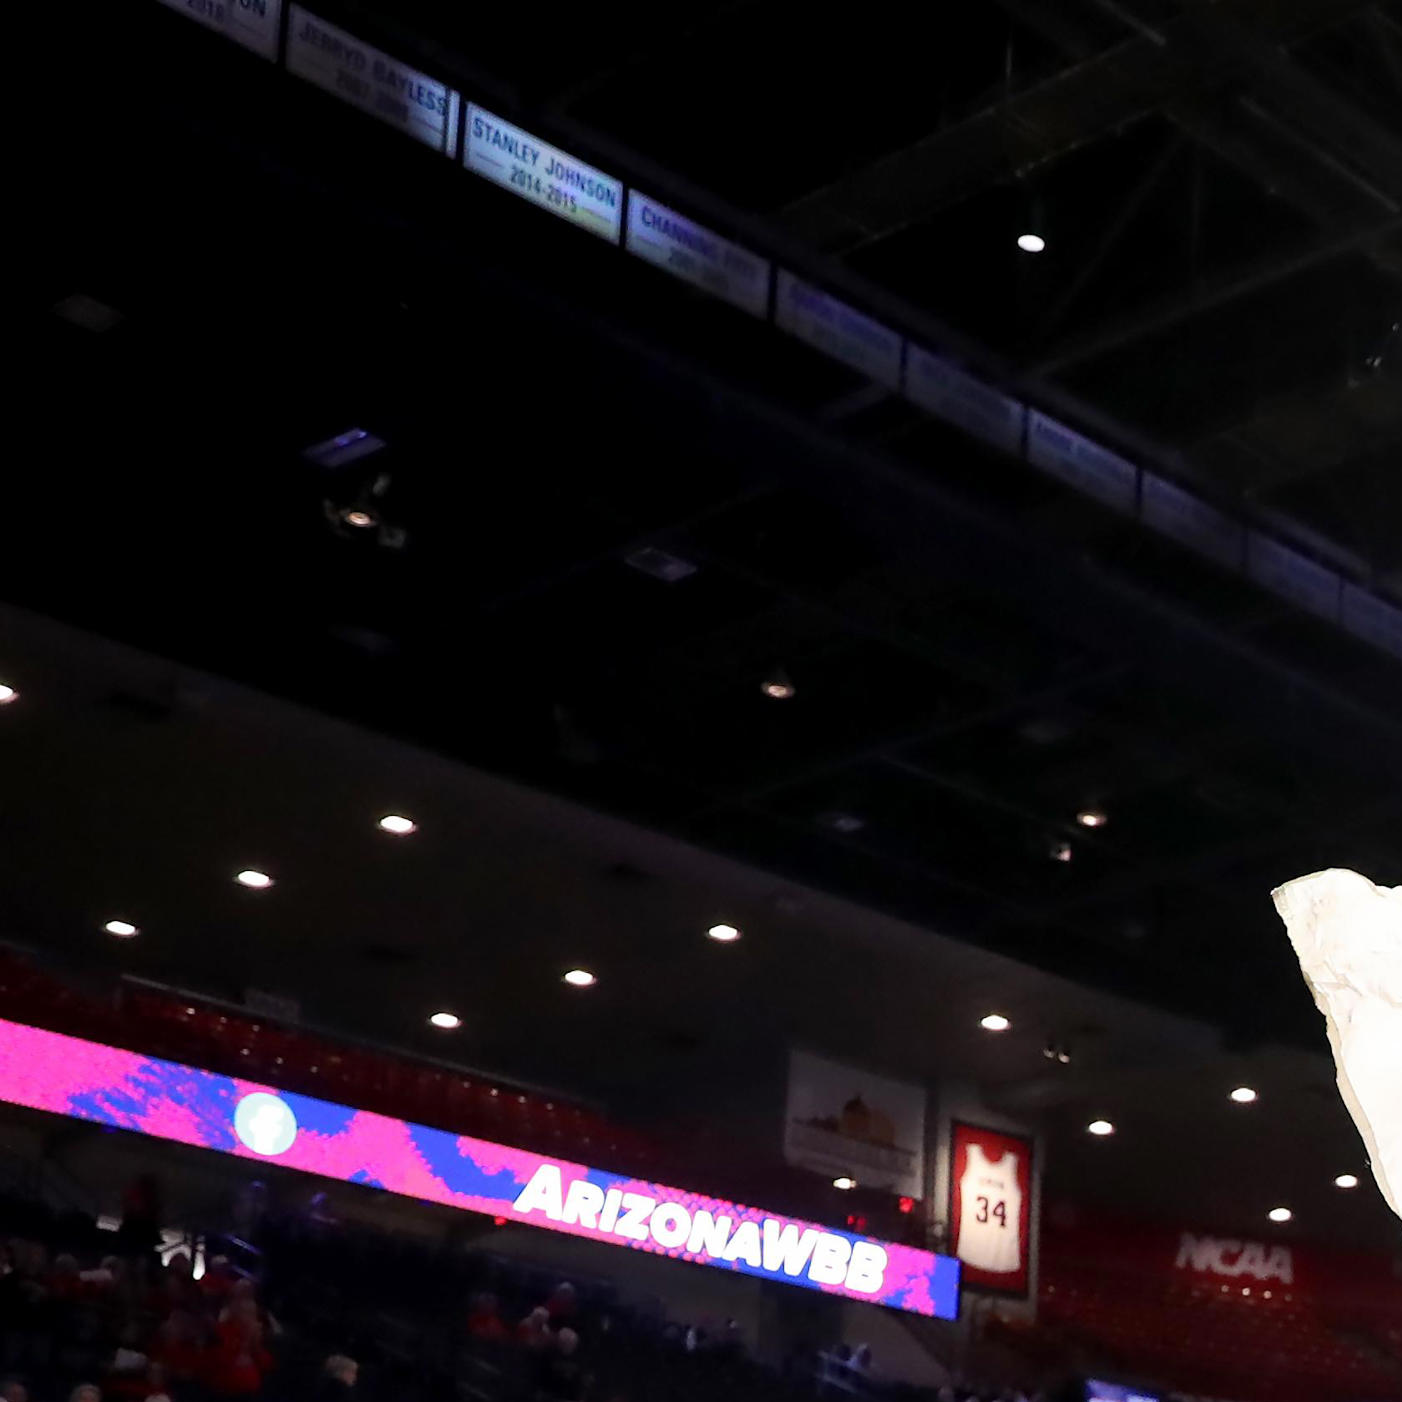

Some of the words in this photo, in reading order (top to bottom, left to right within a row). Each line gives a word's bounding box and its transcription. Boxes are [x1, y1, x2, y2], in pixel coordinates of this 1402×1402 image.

[472, 117, 540, 167] STANLEY
[545, 158, 616, 207] JOHNSON
[510, 164, 578, 213] 2014-2015
[512, 1163, 888, 1294] ARIZONAWBB
[975, 1195, 1007, 1229] 34
[1175, 1231, 1294, 1284] NCAA
